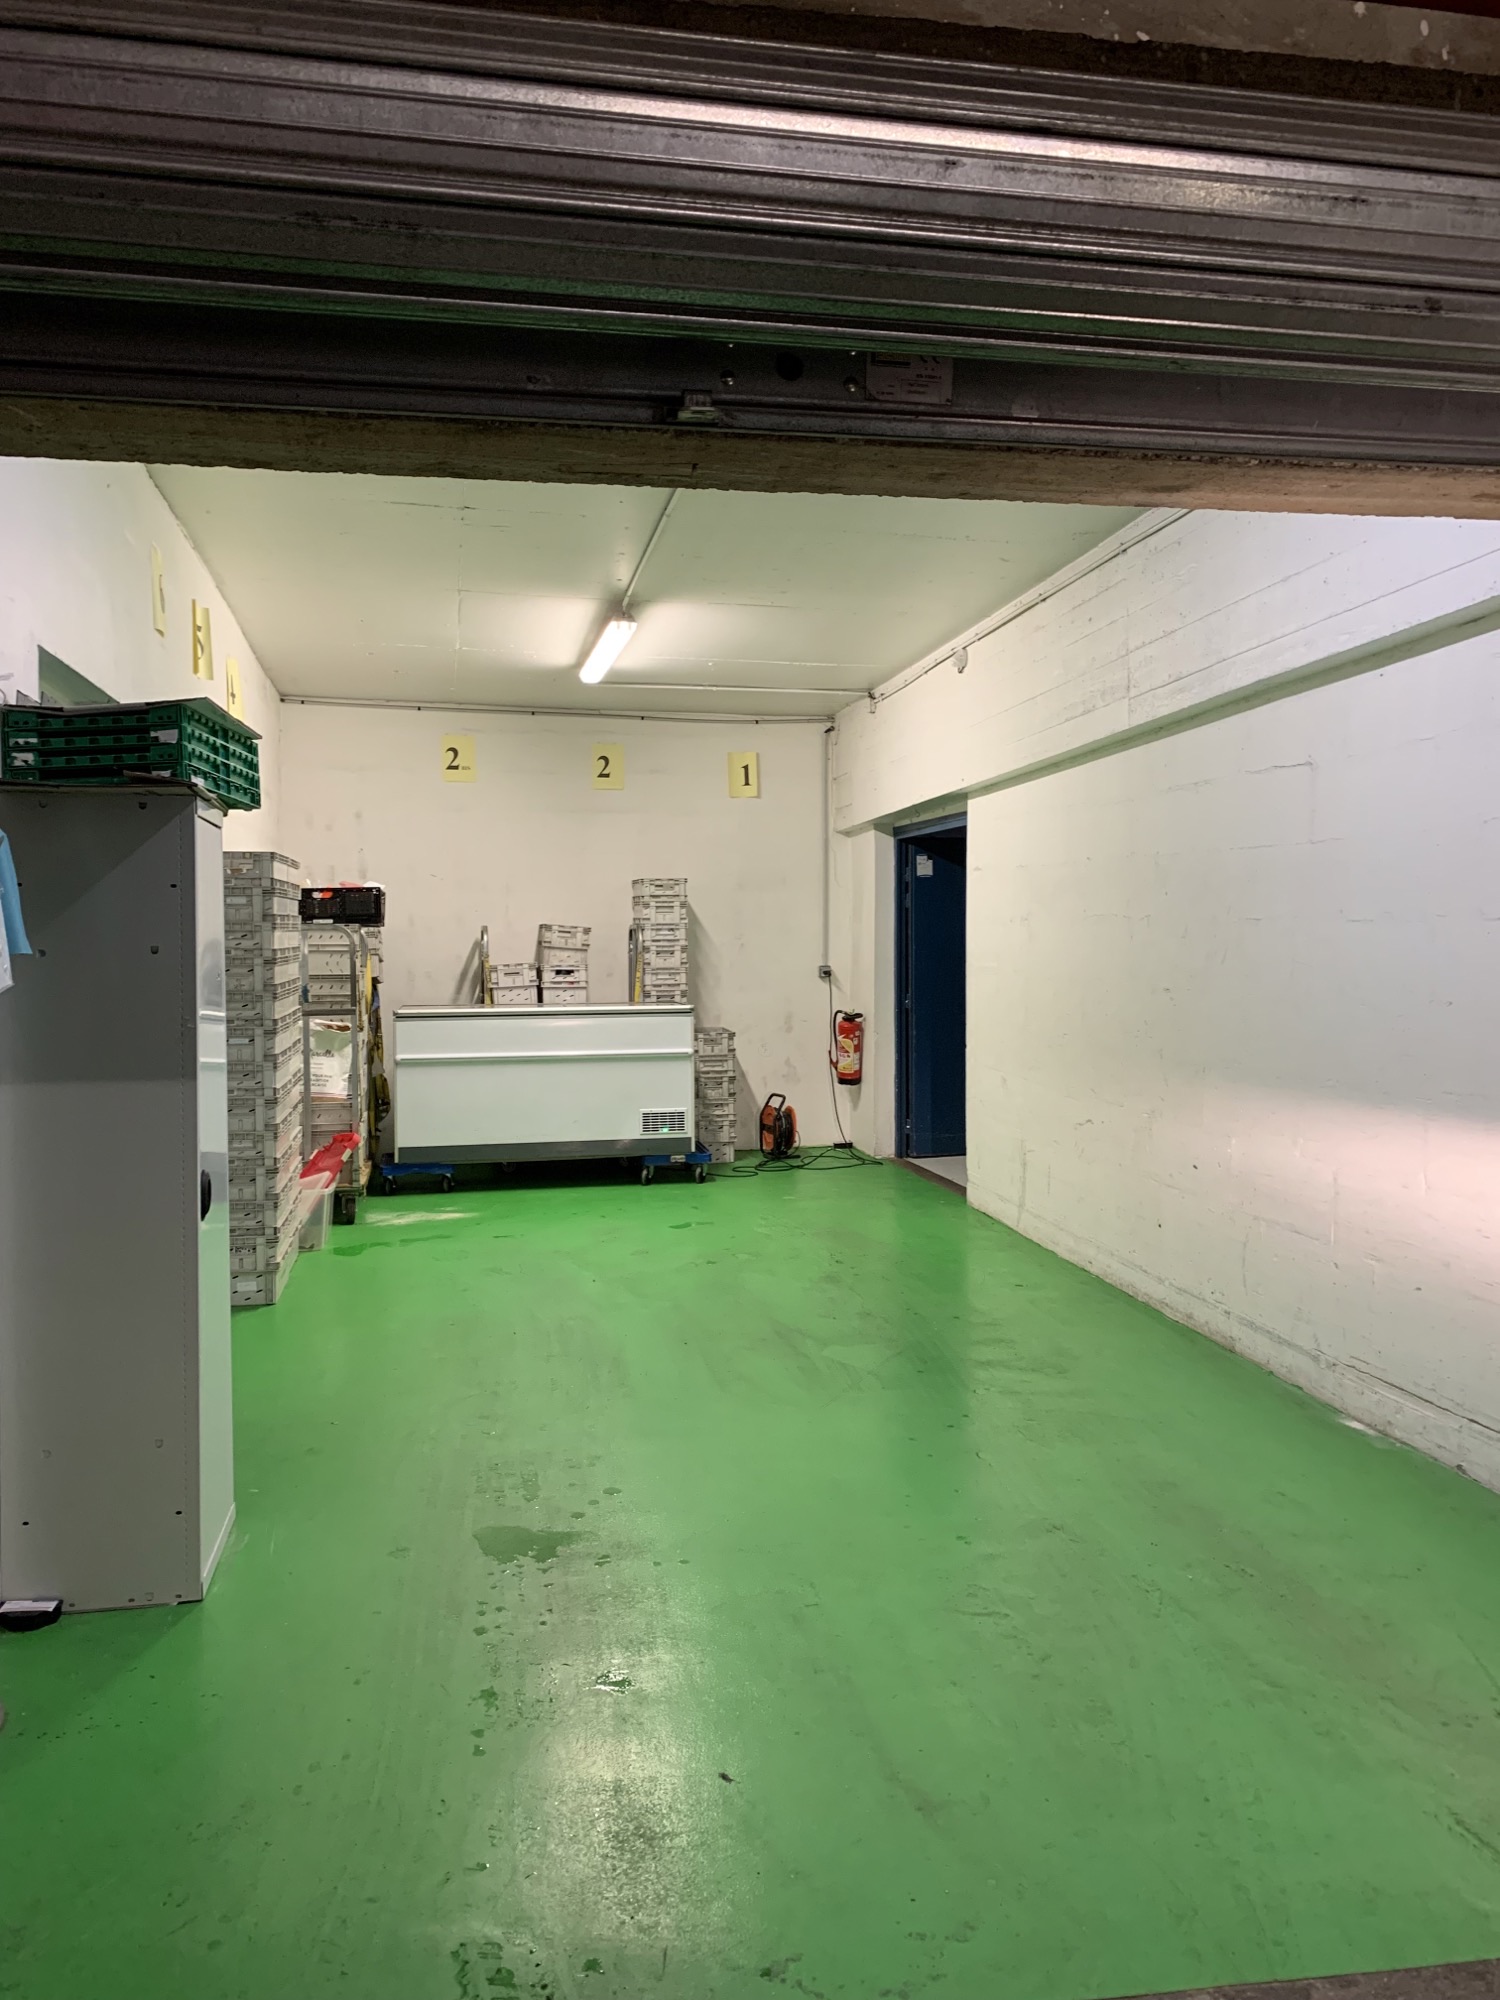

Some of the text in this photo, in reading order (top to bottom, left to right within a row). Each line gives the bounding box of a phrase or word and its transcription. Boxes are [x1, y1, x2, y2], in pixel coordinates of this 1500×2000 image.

[445, 747, 460, 770] 2
[596, 755, 611, 778] 2
[741, 764, 752, 786] 1
